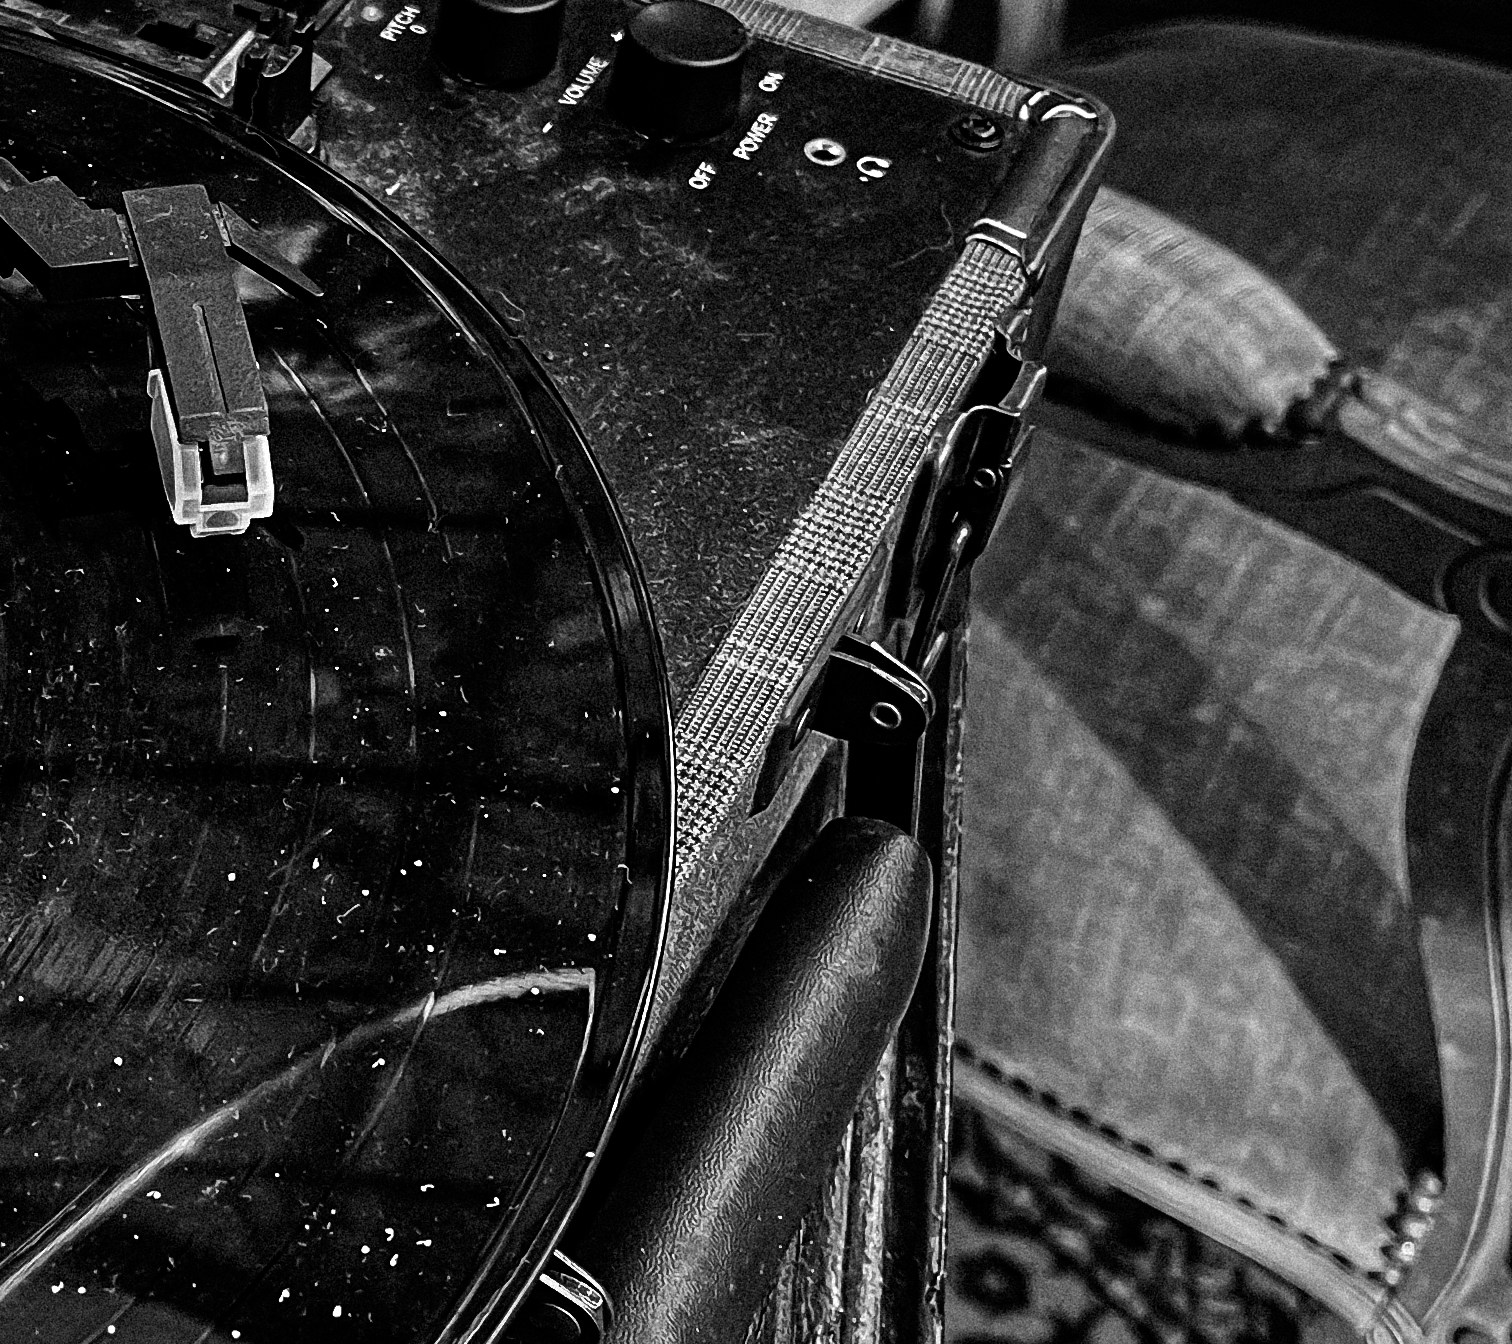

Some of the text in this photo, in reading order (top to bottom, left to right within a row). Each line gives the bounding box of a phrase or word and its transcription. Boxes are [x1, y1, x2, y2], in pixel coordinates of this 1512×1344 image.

[379, 6, 421, 41] PITCH
[558, 56, 609, 105] VOLUME
[758, 72, 785, 92] ON
[733, 112, 779, 161] POWER
[688, 162, 717, 189] OFF
